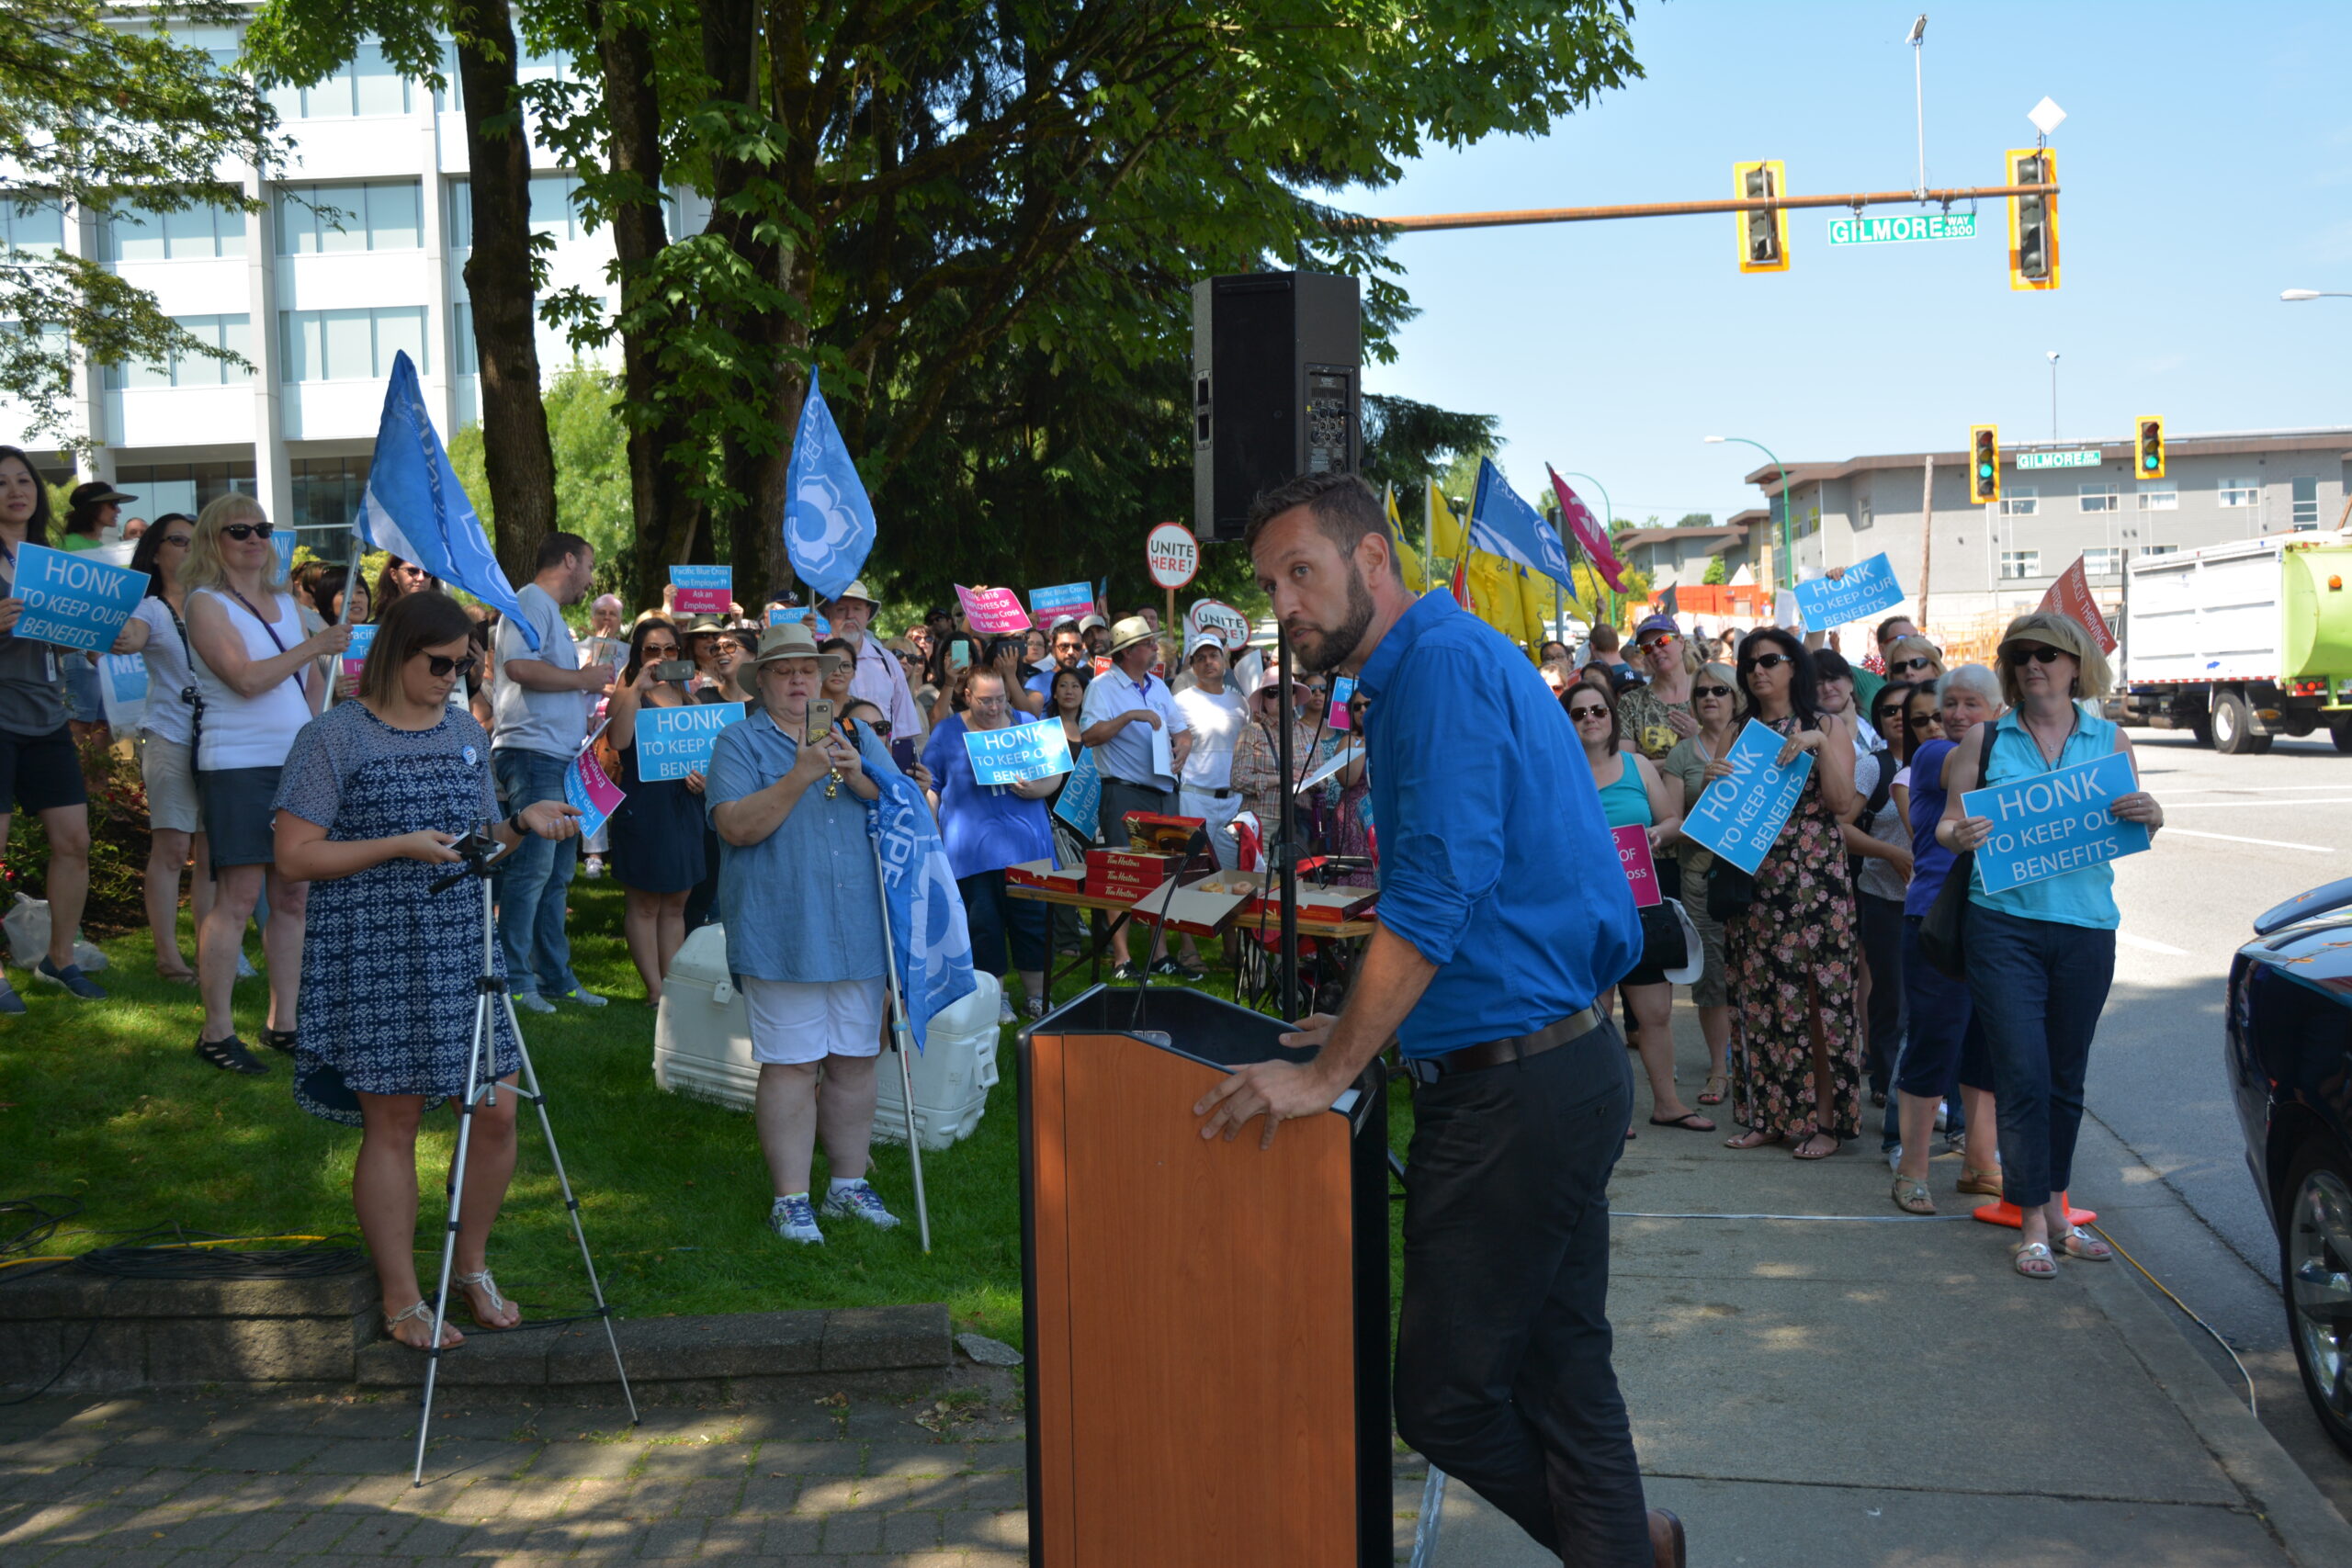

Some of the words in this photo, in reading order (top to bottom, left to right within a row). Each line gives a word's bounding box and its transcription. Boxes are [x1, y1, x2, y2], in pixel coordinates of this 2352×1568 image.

[1832, 217, 1943, 243] GILMORE
[1948, 216, 1969, 226] WAY
[1944, 225, 1973, 236] 3300
[2018, 453, 2083, 468] GILMORE
[1150, 540, 1194, 558] UNITE
[673, 567, 695, 575] Pacific
[696, 567, 710, 575] Blue
[1151, 556, 1192, 573] HERE!
[45, 556, 128, 600] HONK
[691, 579, 719, 588] Employer
[1812, 563, 1874, 598] HONK
[982, 592, 999, 600] 1816
[1000, 599, 1011, 607] OF
[1804, 603, 1824, 615] TO
[1826, 592, 1860, 609] KEEP
[1863, 577, 1893, 597] OUR
[20, 587, 45, 608] TO
[47, 595, 90, 617] KEEP
[92, 605, 128, 626] OUR
[773, 612, 797, 620] Pacific
[1000, 609, 1020, 617] Cross
[1824, 597, 1888, 626] BENEFITS
[1198, 612, 1244, 628] UNITE
[22, 617, 100, 647] BENEFITS
[658, 709, 726, 733] HONK
[642, 741, 664, 756] TO
[668, 738, 706, 753] KEEP
[984, 725, 1046, 750] HONK
[660, 759, 710, 777] BENEF
[975, 755, 994, 767] TO
[997, 750, 1029, 765] KEEP
[992, 762, 1057, 783] BENEFITS
[1701, 742, 1763, 822] HONK
[1064, 759, 1094, 807] HONK
[1717, 827, 1742, 851] TO
[1735, 784, 1768, 828] KEEP
[1762, 747, 1786, 784] OU
[1997, 768, 2107, 821] HONK
[583, 798, 597, 820] Top
[1074, 813, 1087, 825] TO
[1085, 789, 1099, 811] KEEP
[1750, 773, 1803, 852] BENEFITS
[1986, 833, 2014, 857] TO
[2021, 818, 2076, 848] KEEP
[2084, 807, 2119, 830] OU
[1107, 854, 1118, 863] Tim
[1118, 856, 1139, 867] Hortons
[1619, 848, 1636, 862] OF
[2011, 837, 2119, 882] BENEFITS
[1107, 870, 1118, 880] Tim
[1118, 872, 1139, 883] Hortons
[1625, 868, 1646, 880] oss
[1105, 886, 1116, 895] Tim
[1116, 887, 1137, 898] Hortons
